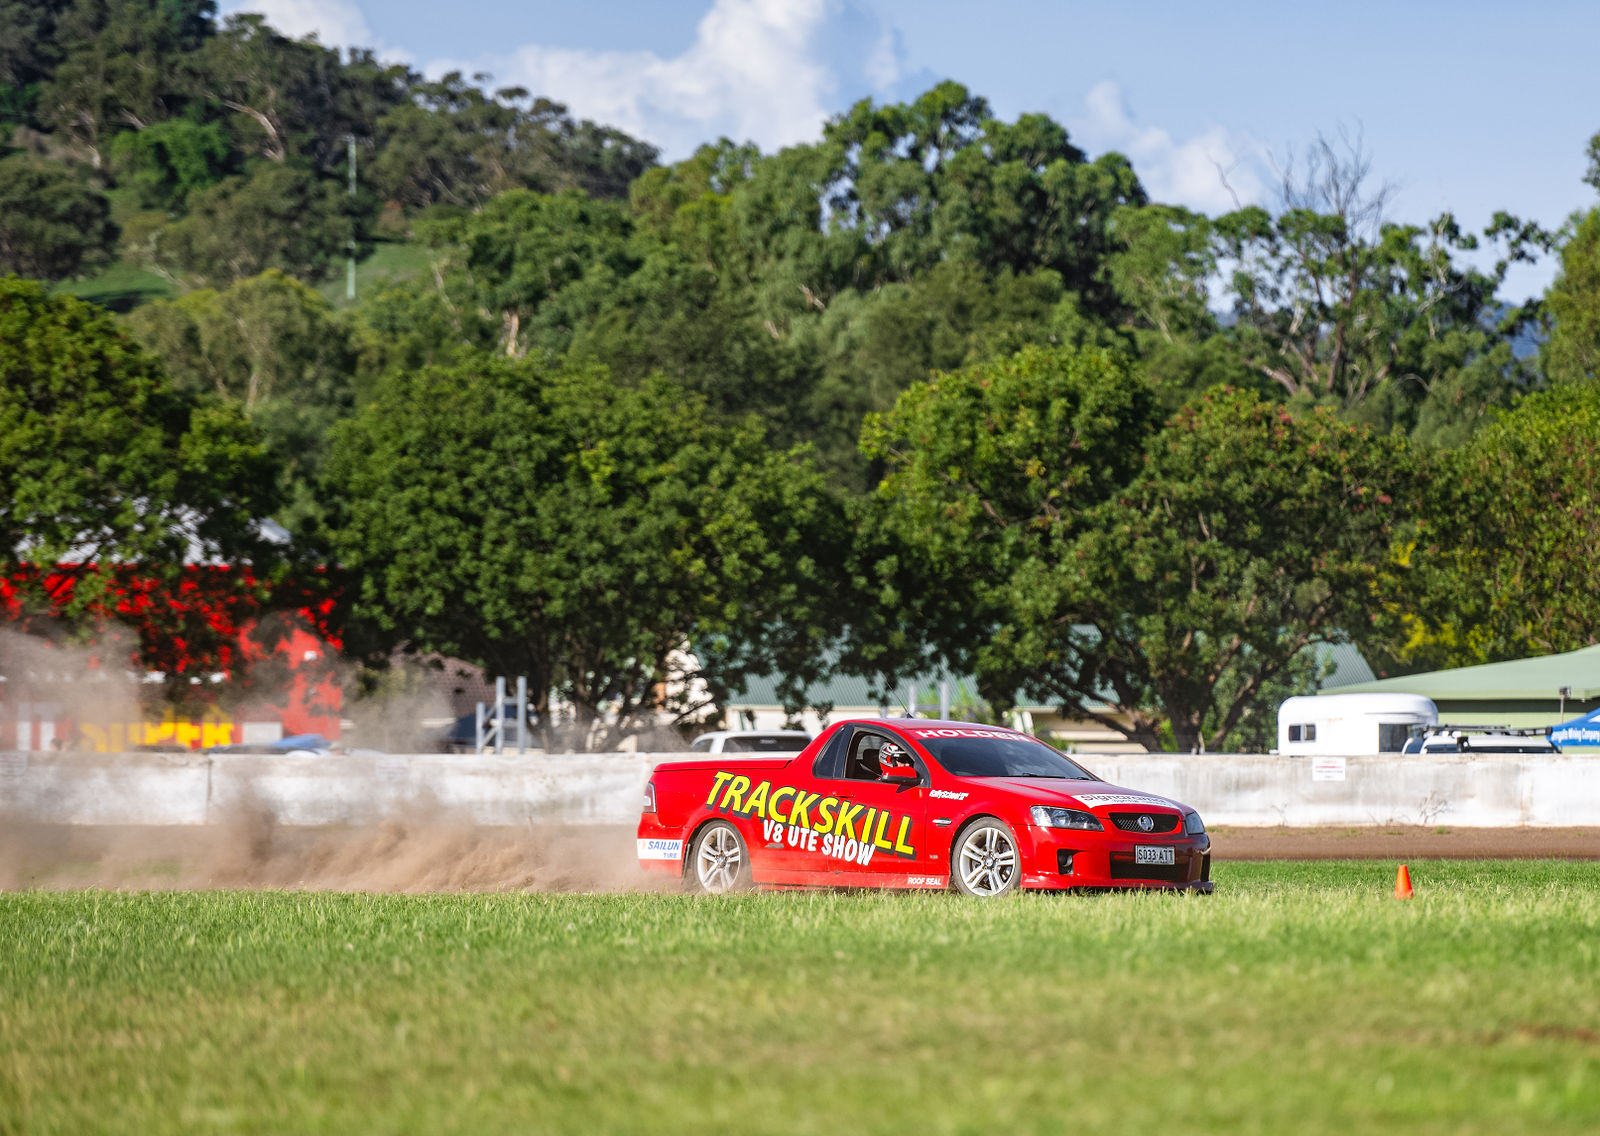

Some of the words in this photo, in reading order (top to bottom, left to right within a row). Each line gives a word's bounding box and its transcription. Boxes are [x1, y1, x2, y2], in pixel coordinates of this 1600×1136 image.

[915, 729, 1031, 742] HOLDEN
[706, 771, 915, 857] TRACKSKILL
[648, 840, 681, 851] SAILUN
[763, 819, 784, 843] V8
[787, 825, 819, 852] UTE
[821, 833, 876, 866] SHOW
[907, 877, 925, 885] ROOF
[925, 878, 942, 886] SEAL
